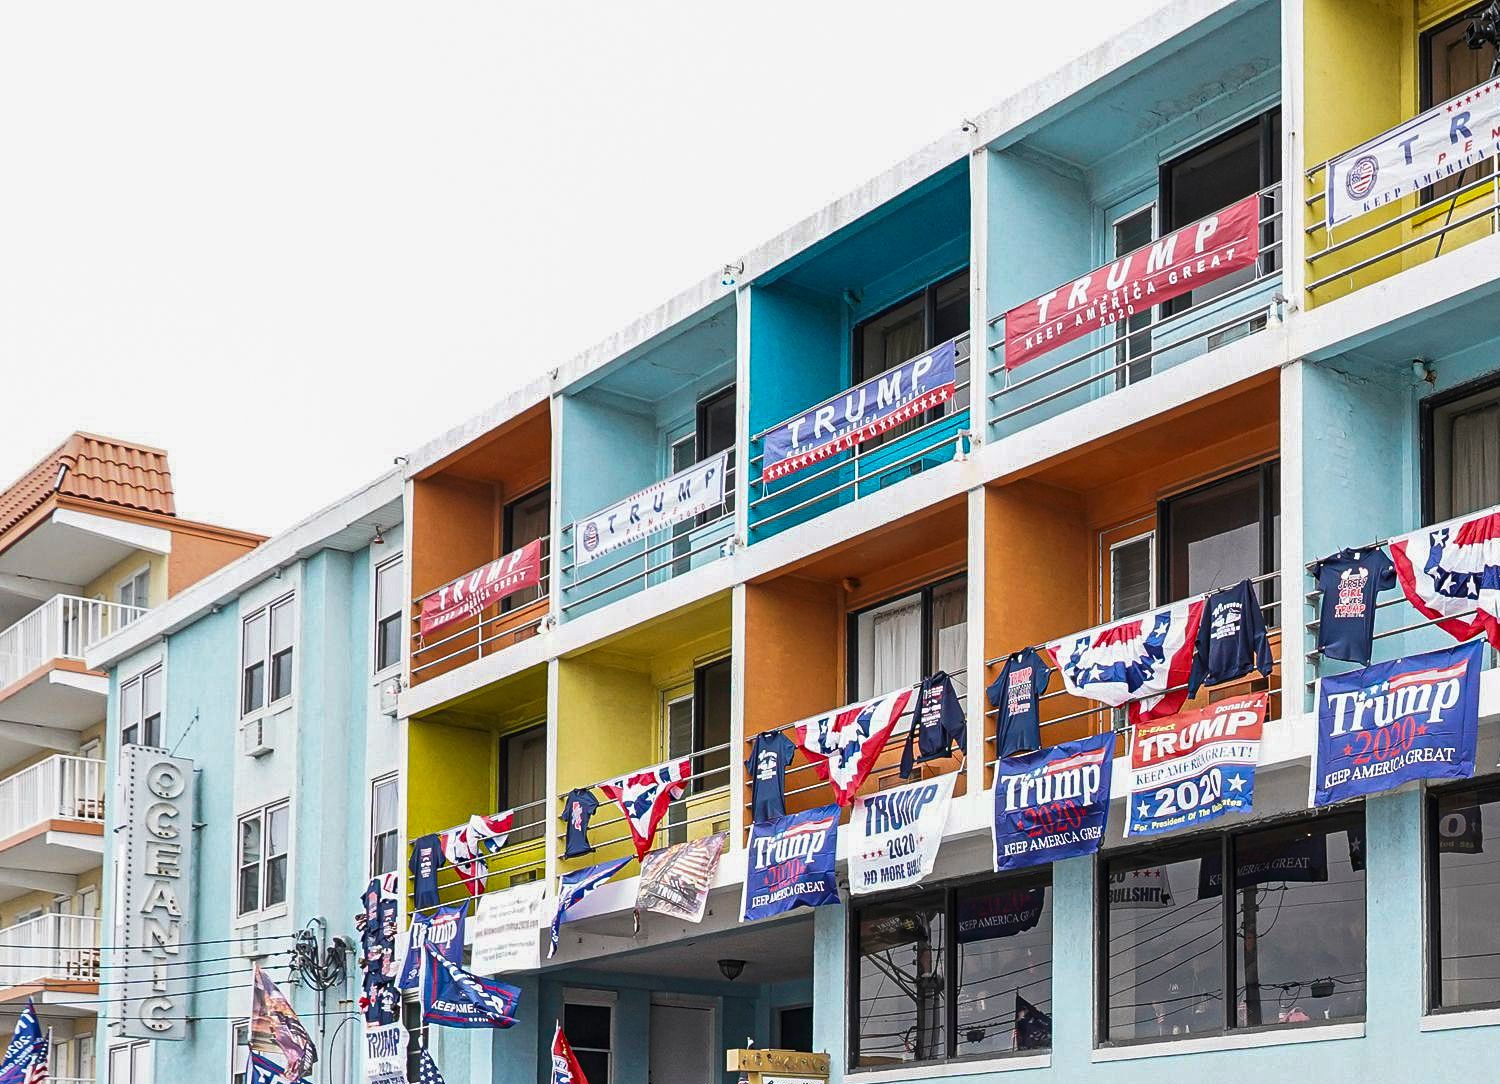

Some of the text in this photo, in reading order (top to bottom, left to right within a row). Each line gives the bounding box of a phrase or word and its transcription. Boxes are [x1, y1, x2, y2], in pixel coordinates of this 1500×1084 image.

[1363, 187, 1401, 212] KEEP
[1412, 148, 1485, 191] AMERICA
[1036, 215, 1220, 325] TRUMP
[1025, 248, 1236, 350] KEEP AMERICA GREAT
[1099, 305, 1135, 327] 2020
[787, 355, 933, 449] TRUMP
[832, 413, 878, 440] AMERICA
[836, 426, 877, 451] 2020
[608, 468, 715, 534] TRUMP
[438, 549, 524, 610] TRUMP
[494, 571, 527, 593] GREAT
[1338, 577, 1369, 590] JERSEY
[1339, 588, 1363, 599] GIRL
[1335, 604, 1366, 614] TRUMP
[1009, 667, 1032, 684] TRUMP
[1215, 700, 1251, 714] Donald
[1328, 678, 1460, 737] Trump
[1138, 711, 1258, 762] TRUMP
[1353, 716, 1416, 765] 2020
[1136, 746, 1253, 785] KEEP GREAT!
[1324, 748, 1456, 789] KEEP AMERICA GREAT
[1001, 763, 1100, 812] Trump
[1154, 768, 1222, 817] 2020
[864, 784, 938, 837] TRUMP
[1024, 799, 1082, 838] 2020
[1134, 807, 1210, 831] For President Of The
[753, 830, 826, 869] Trump
[887, 833, 915, 859] 2020
[1004, 825, 1102, 857] KEEP AMERICA GREA
[864, 863, 905, 885] NO MORE
[1271, 857, 1311, 869] GREAT
[139, 761, 186, 1033] OCEANIC
[657, 884, 682, 903] TRUMP
[752, 896, 770, 908] KEEP
[794, 880, 824, 895] GREAT
[1108, 887, 1162, 904] BULLSHIT
[959, 913, 1019, 932] KEEP AMERICA
[432, 1000, 456, 1011] KEEP
[366, 1027, 400, 1058] TRUMP
